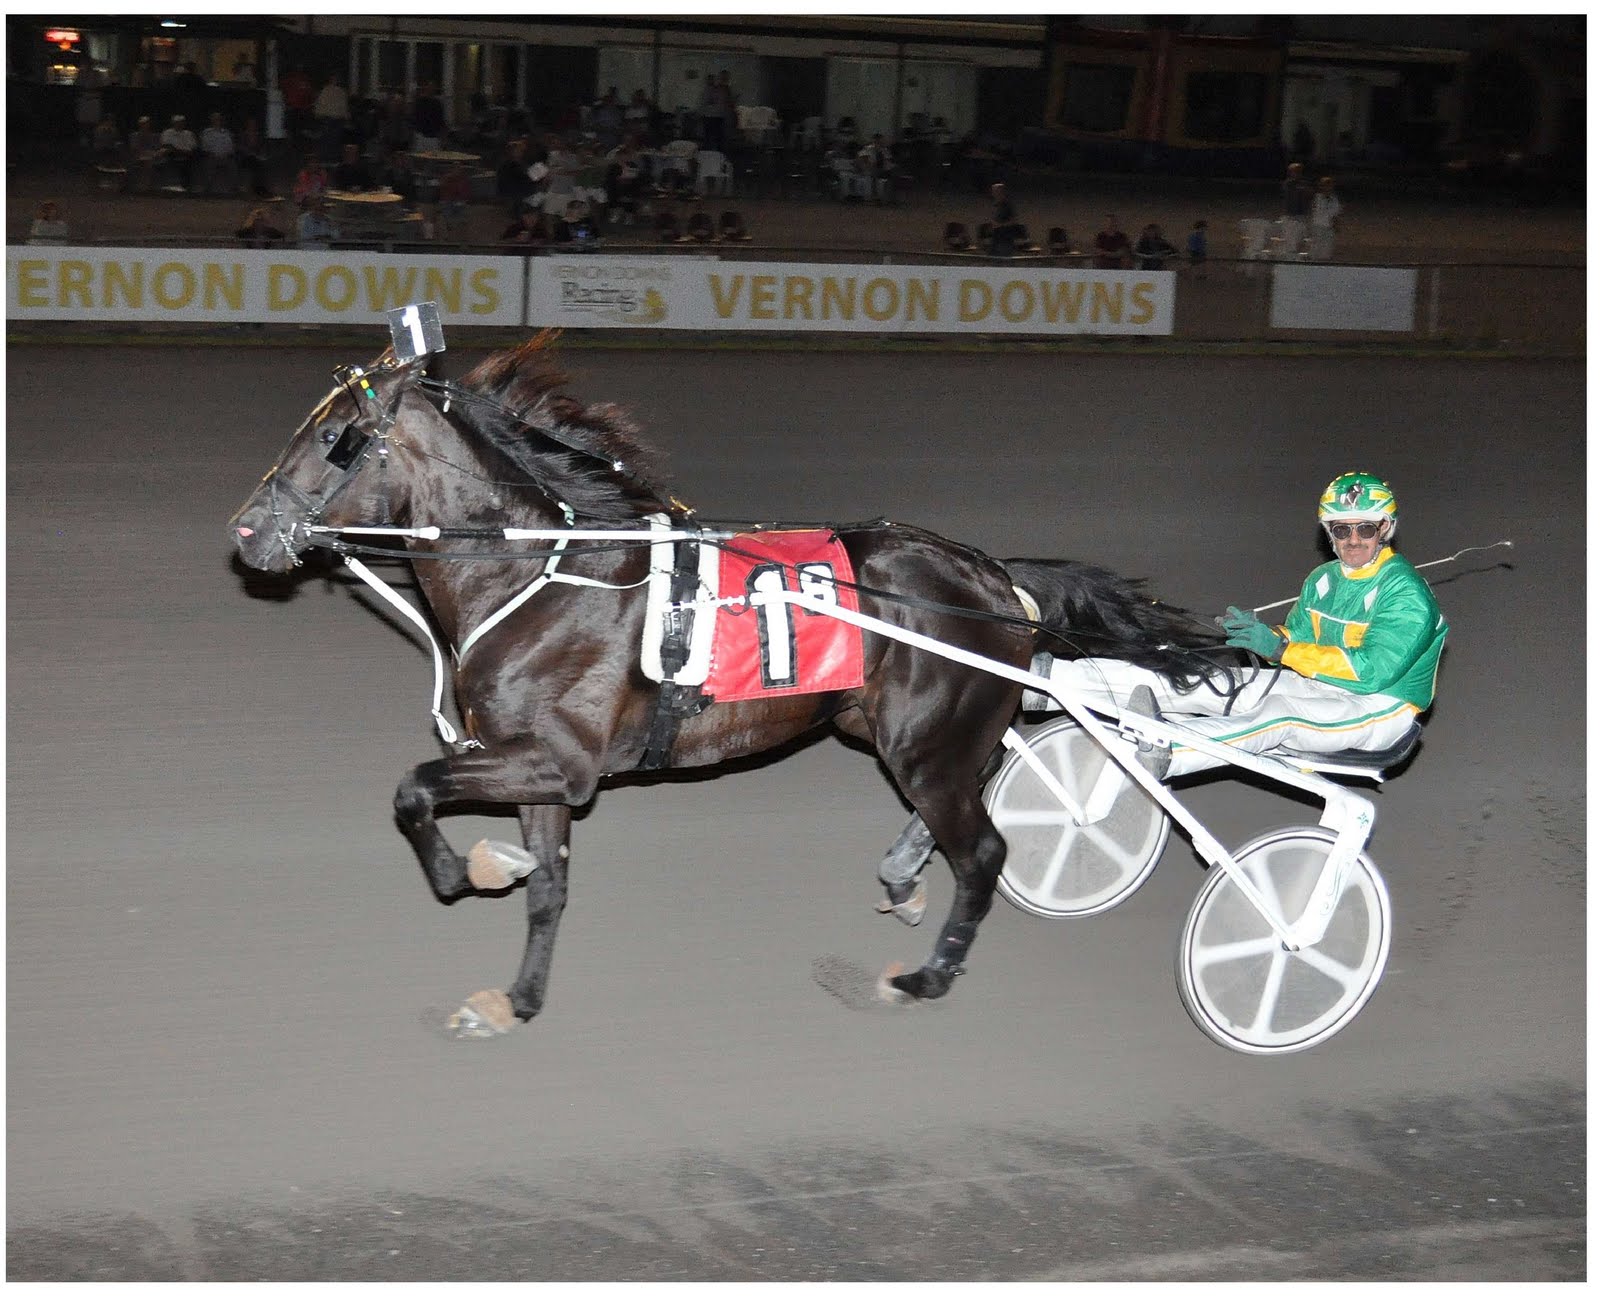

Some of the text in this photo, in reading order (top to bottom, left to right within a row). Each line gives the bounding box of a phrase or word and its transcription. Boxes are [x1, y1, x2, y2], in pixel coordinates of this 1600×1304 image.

[6, 259, 500, 315] ERNON DOWNS
[708, 274, 1156, 325] VERNON DOWNS
[402, 304, 427, 356] 1
